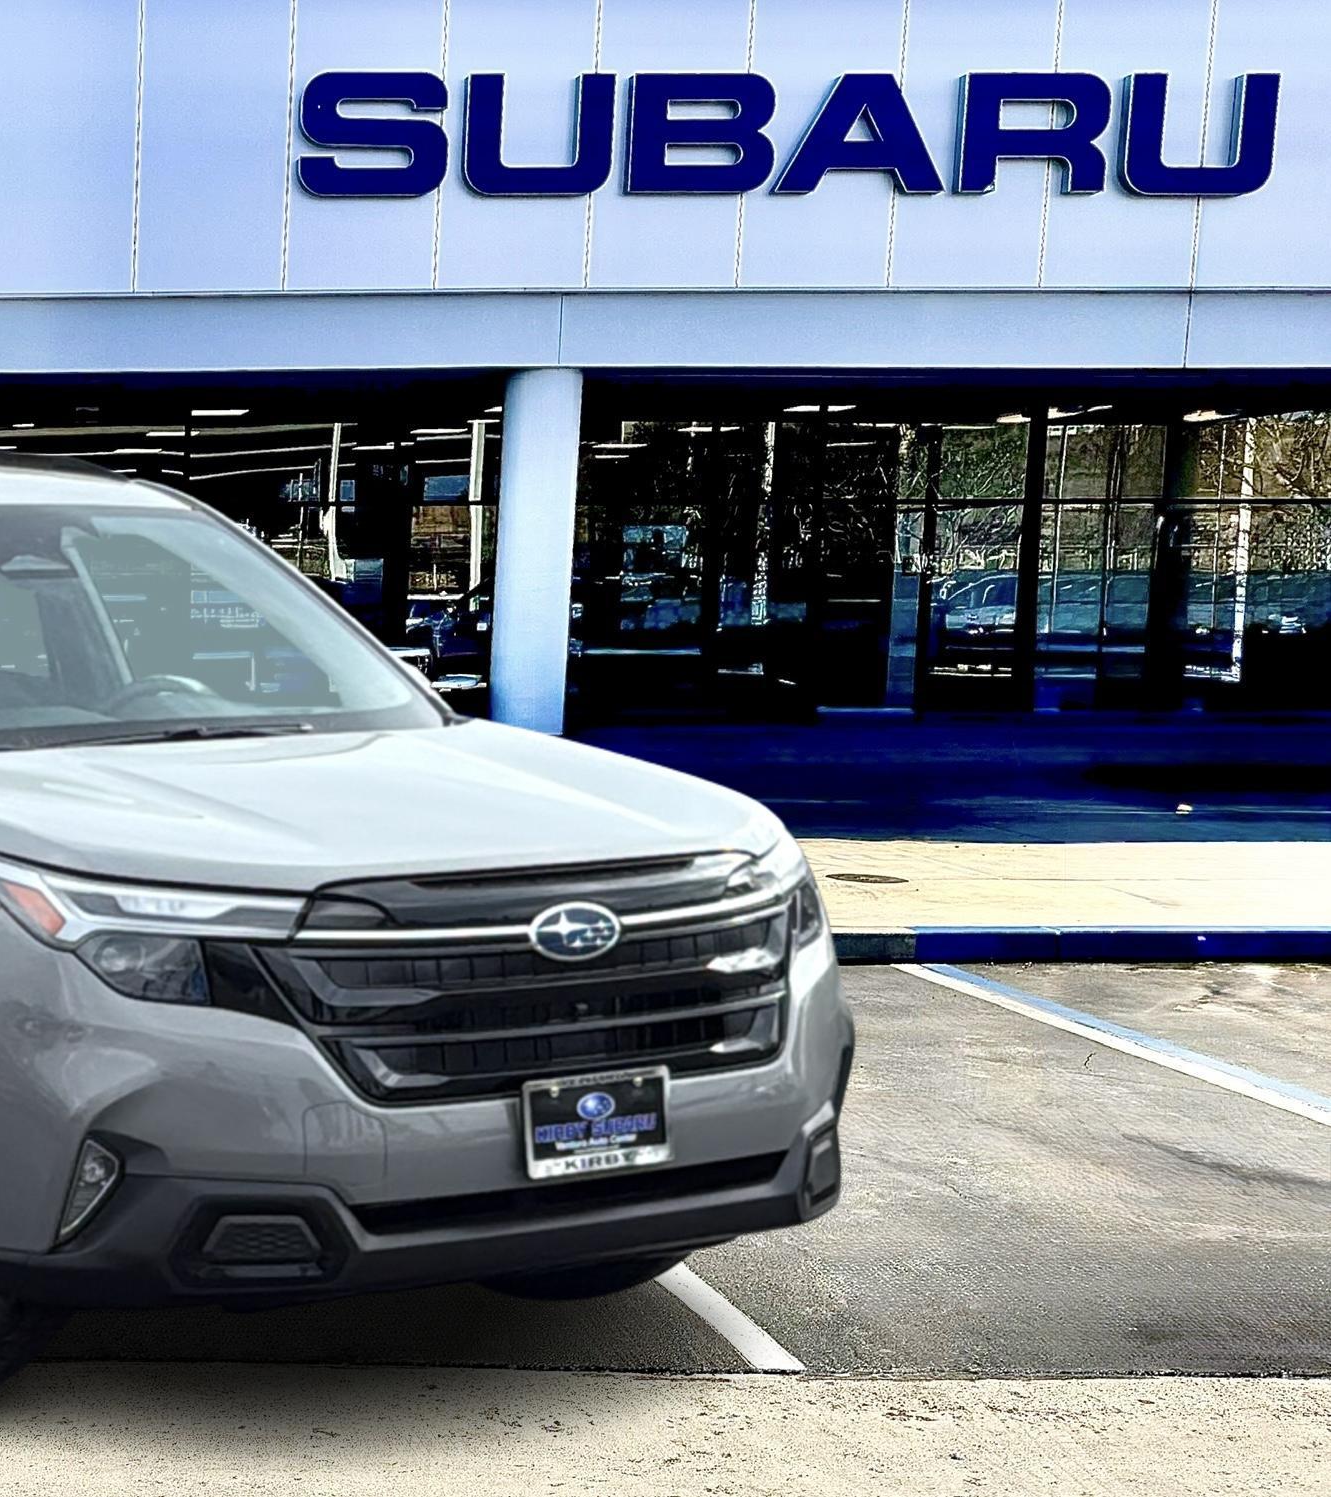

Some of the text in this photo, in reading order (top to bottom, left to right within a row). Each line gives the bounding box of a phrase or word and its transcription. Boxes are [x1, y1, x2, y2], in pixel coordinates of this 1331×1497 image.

[296, 70, 1281, 197] SUBARU
[535, 1113, 657, 1143] KIRBY SUBARU
[565, 1152, 638, 1170] KIRBY
